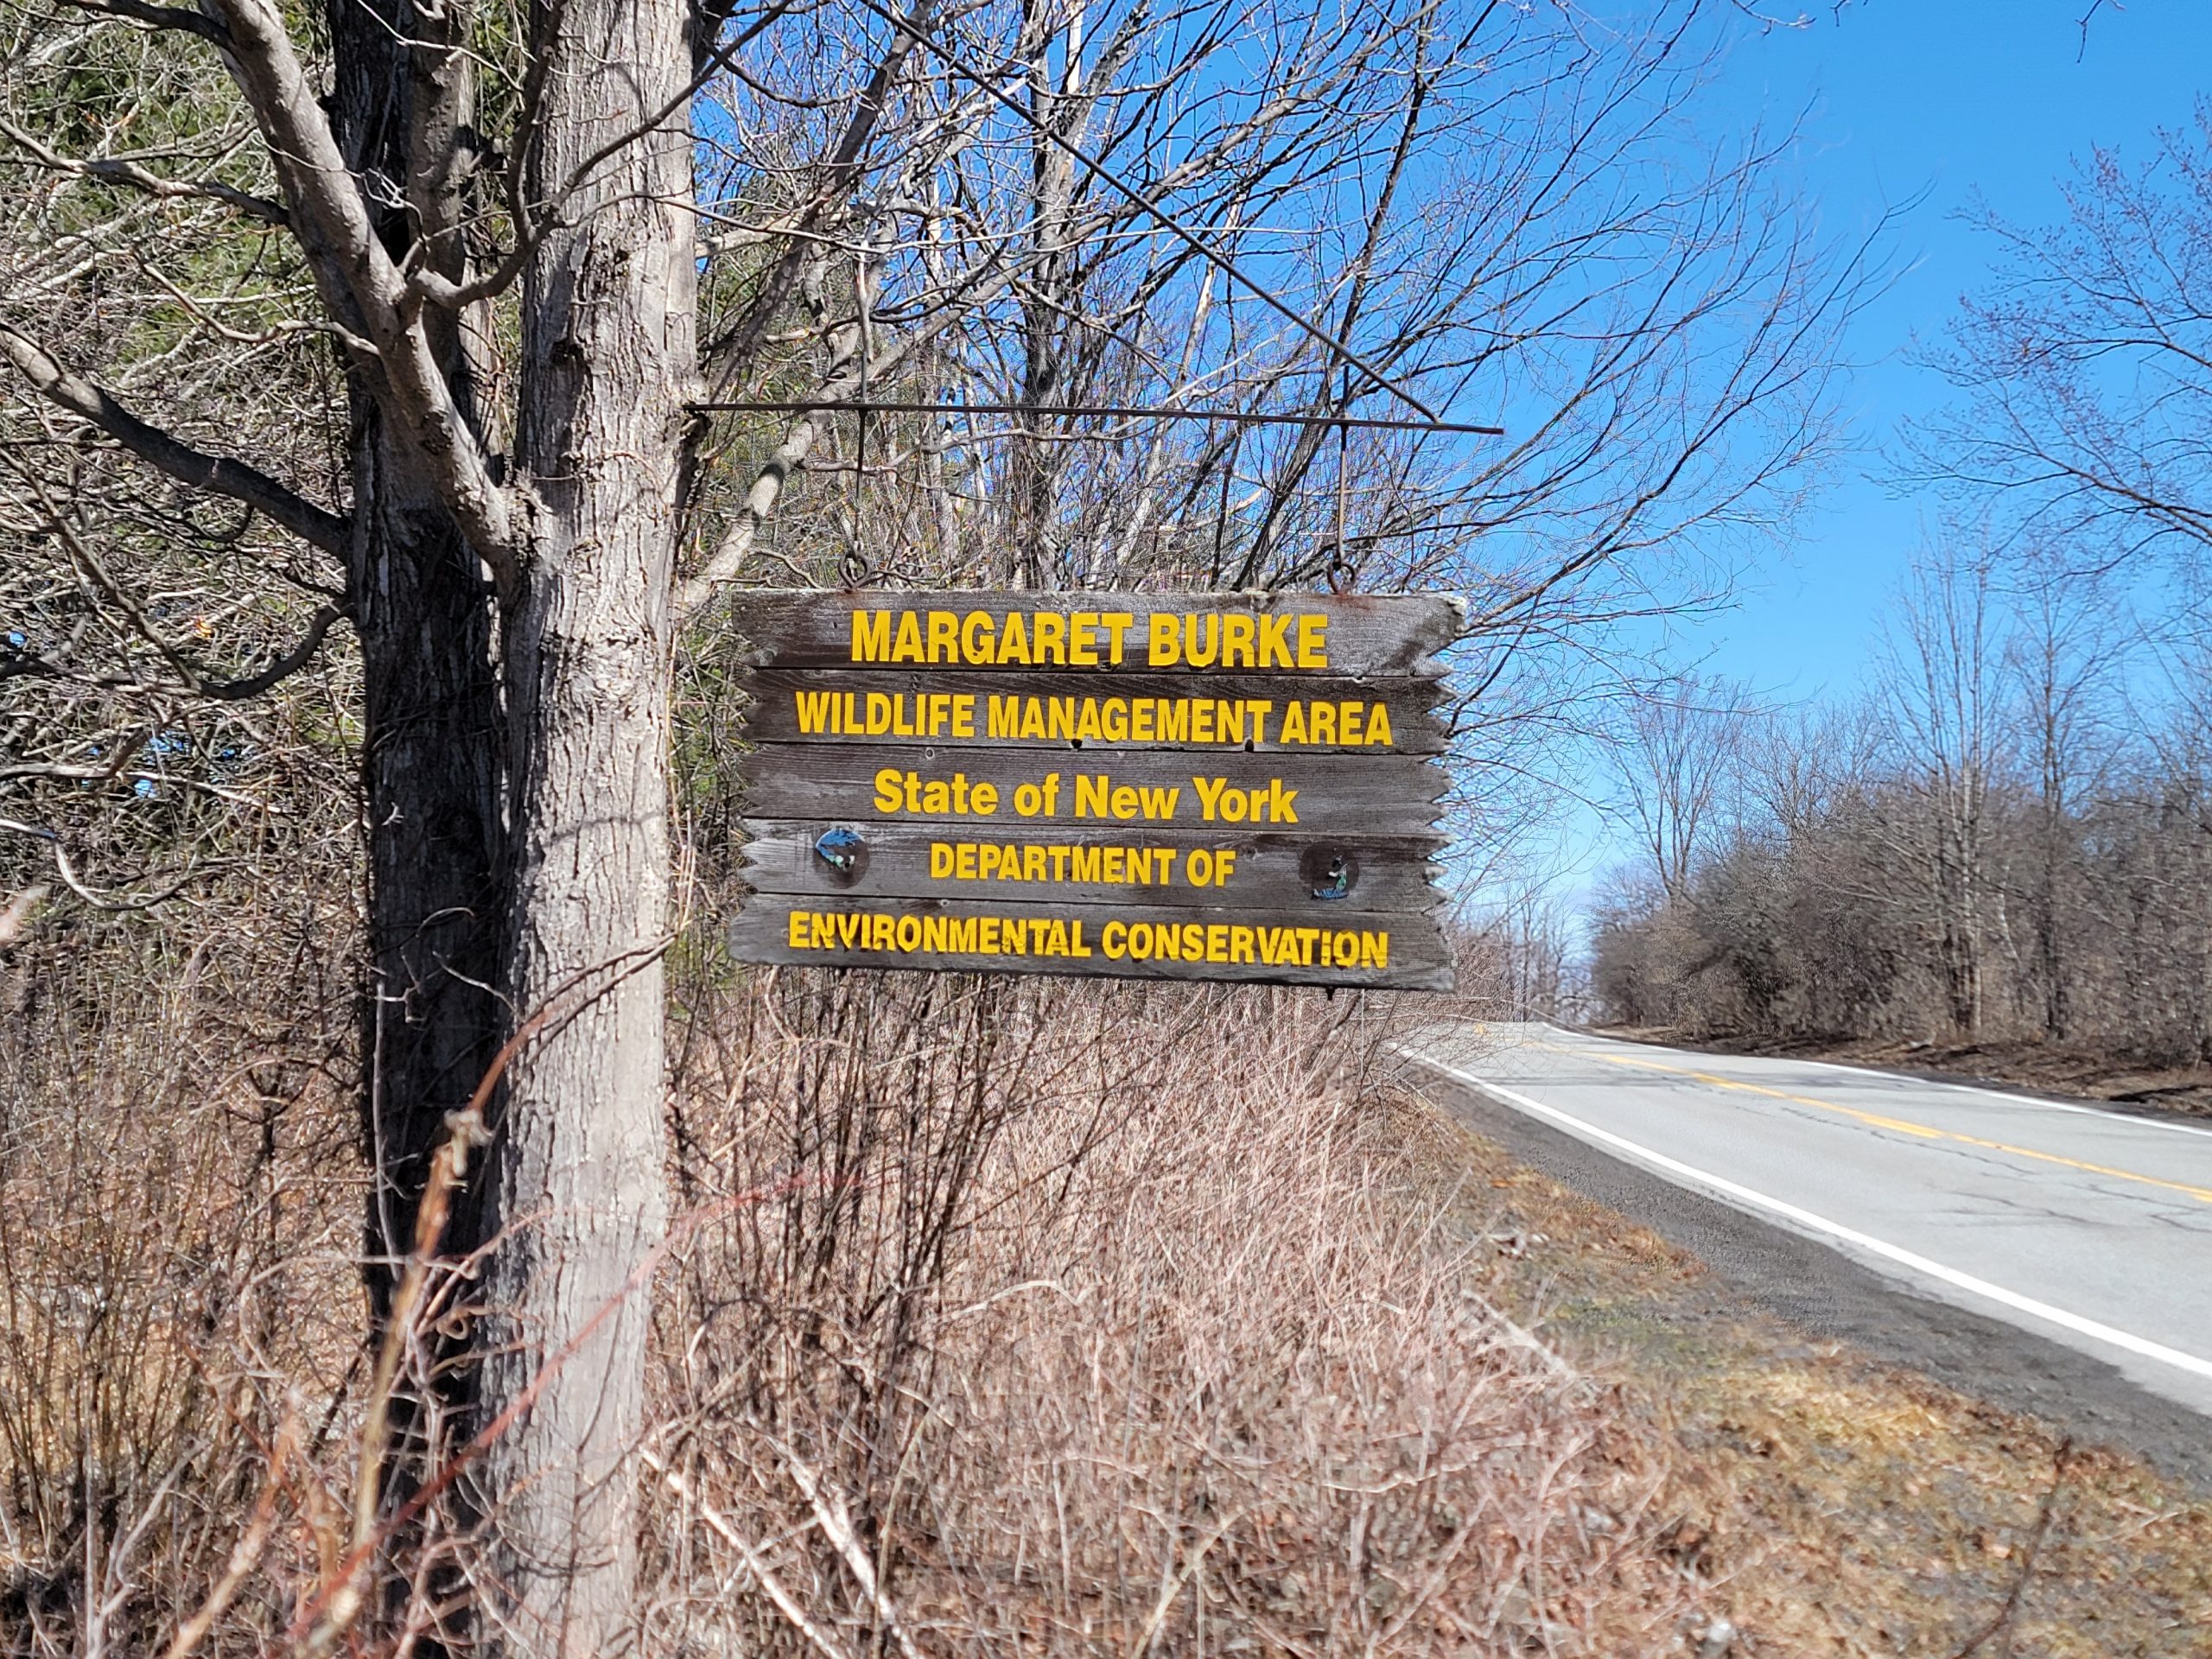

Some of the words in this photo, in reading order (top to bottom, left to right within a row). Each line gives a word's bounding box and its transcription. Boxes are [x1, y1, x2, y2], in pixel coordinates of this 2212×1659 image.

[850, 608, 1134, 665] MARGARET
[1147, 613, 1329, 668] BURKE
[795, 690, 976, 738] WILDLIFE
[987, 695, 1272, 744] MANAGEMENT
[1280, 700, 1394, 747] AREA
[873, 767, 999, 816] State
[1013, 772, 1060, 817] of
[1074, 773, 1180, 820] New
[1192, 776, 1299, 824] York
[929, 842, 1178, 887] DEPARTMENT
[1186, 848, 1236, 888] OF
[788, 910, 1092, 958] ENVIRONMENTAL
[1102, 919, 1389, 969] CONSERVATION
